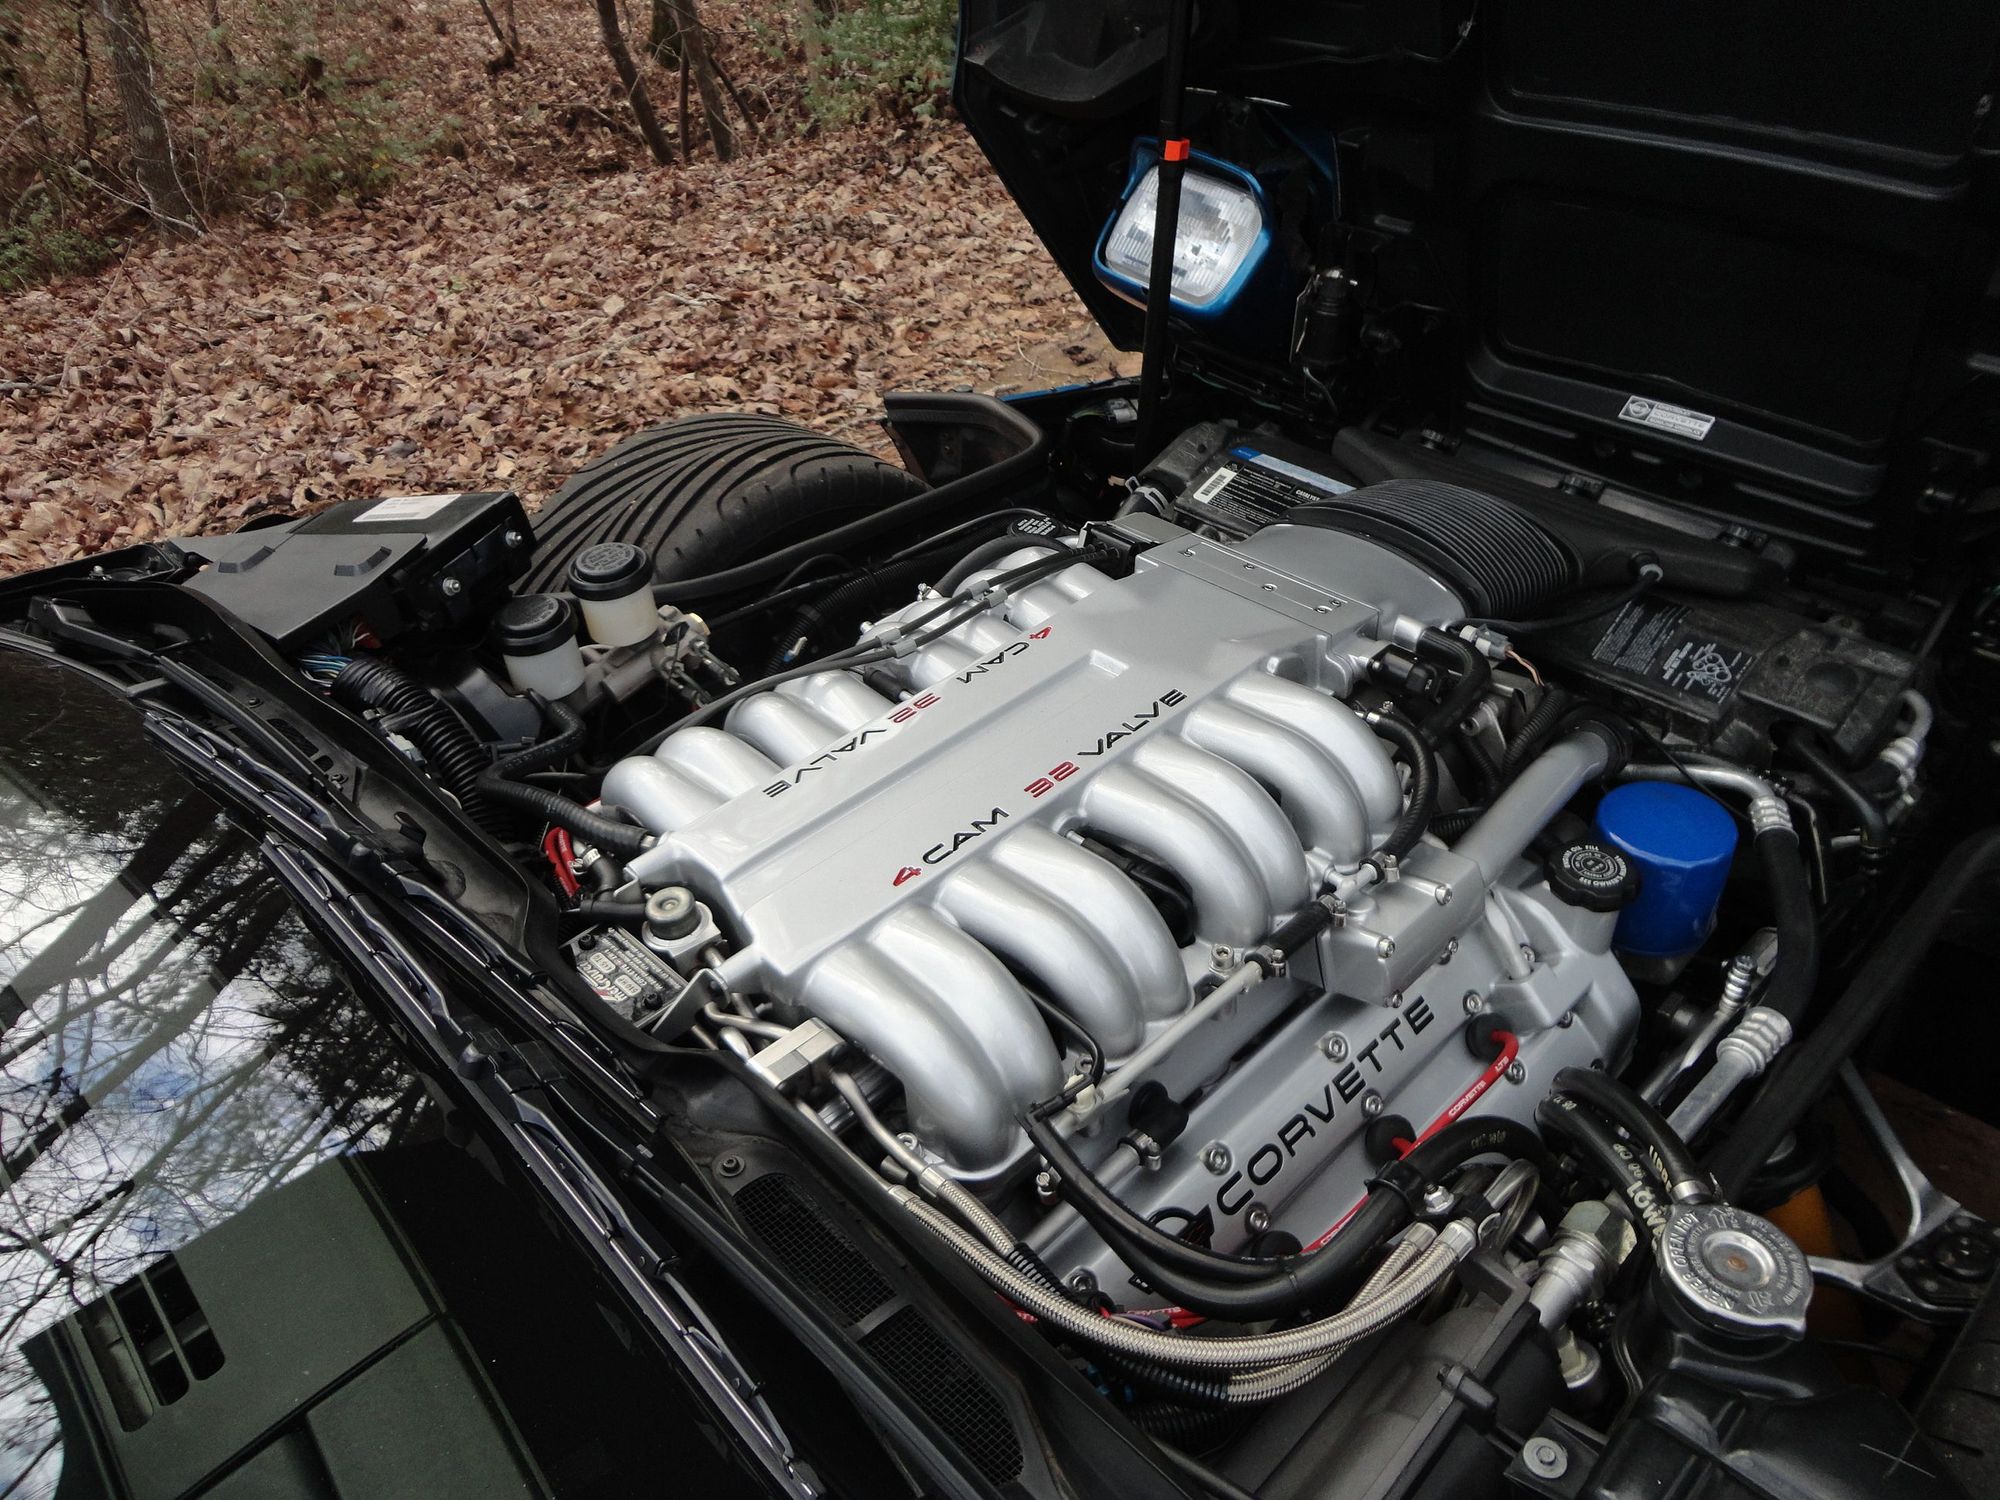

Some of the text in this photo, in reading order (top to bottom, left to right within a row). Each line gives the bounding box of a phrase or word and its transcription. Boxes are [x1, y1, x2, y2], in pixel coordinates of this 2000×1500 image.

[763, 625, 1053, 798] 4 CAM 32 VALVE
[893, 688, 1188, 887] 4 CAM 32 VALVE
[1217, 995, 1434, 1217] CORVETTE
[1448, 1080, 1487, 1118] CORVETTE
[1669, 1211, 1735, 1310] NEVER OPEN HOT
